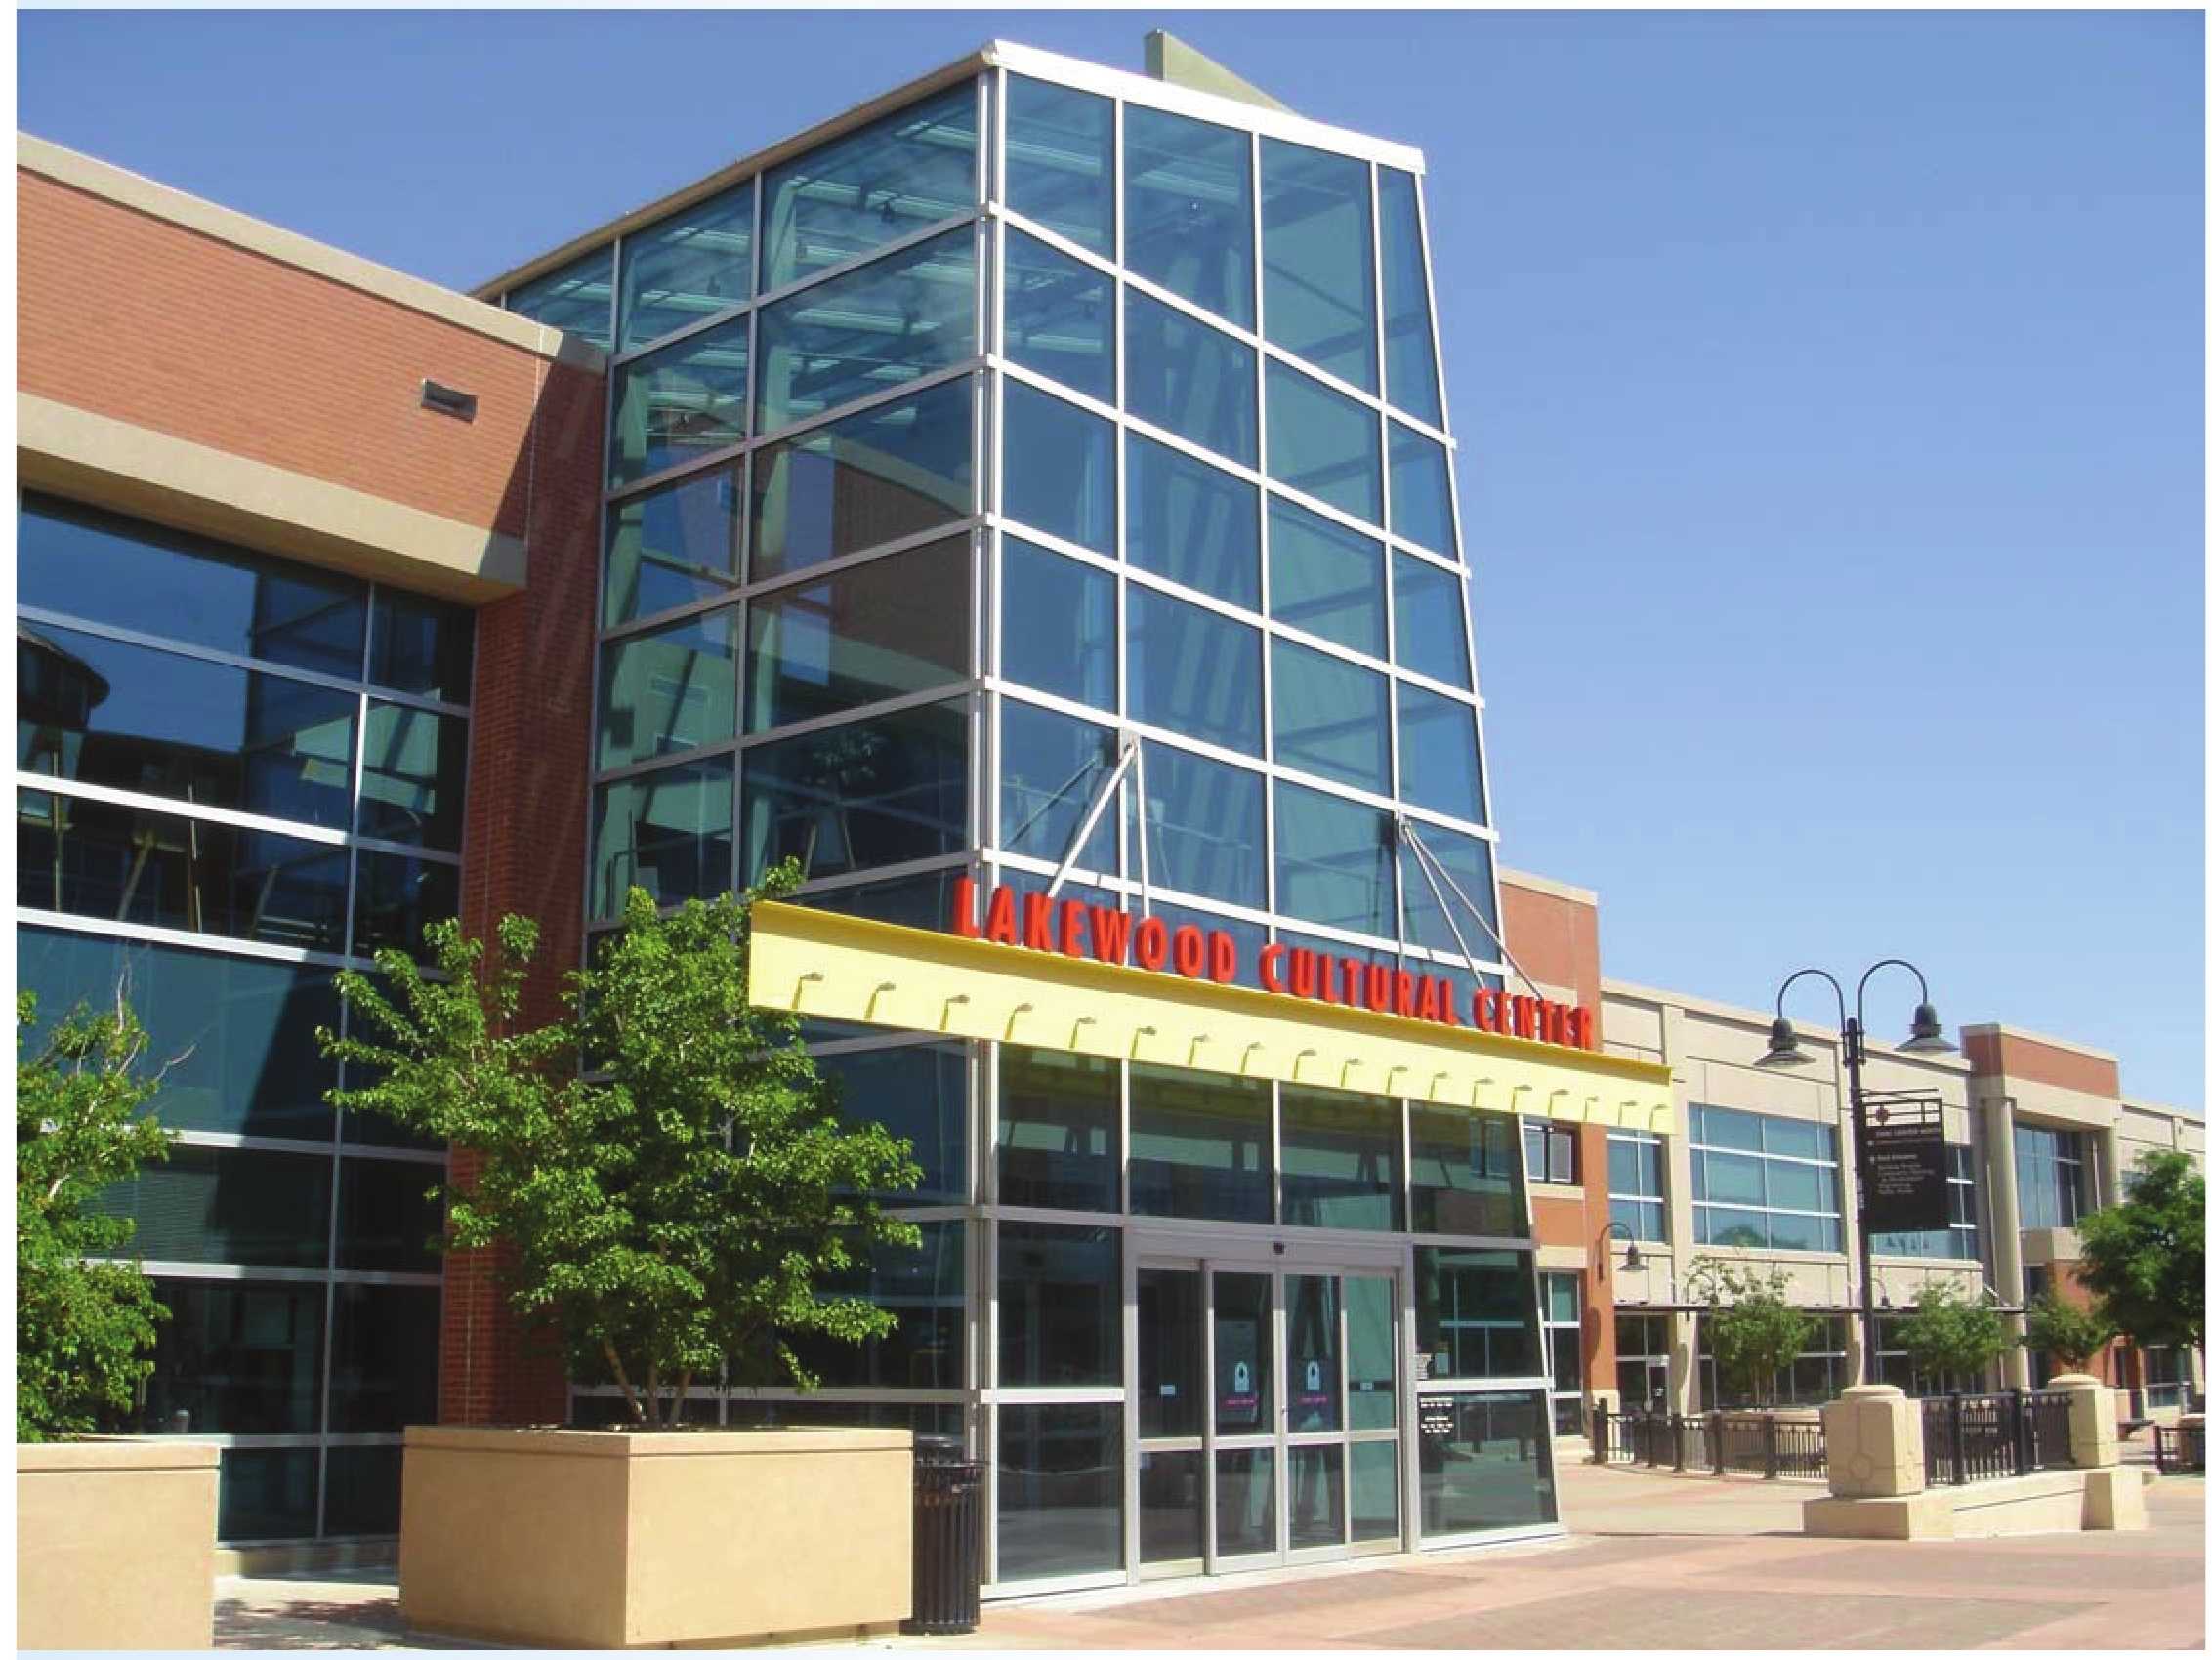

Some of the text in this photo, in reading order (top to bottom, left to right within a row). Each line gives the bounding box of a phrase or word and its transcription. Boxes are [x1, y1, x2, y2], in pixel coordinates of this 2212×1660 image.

[953, 877, 1595, 1052] LAKEWOOD CULTURAL CENTER
